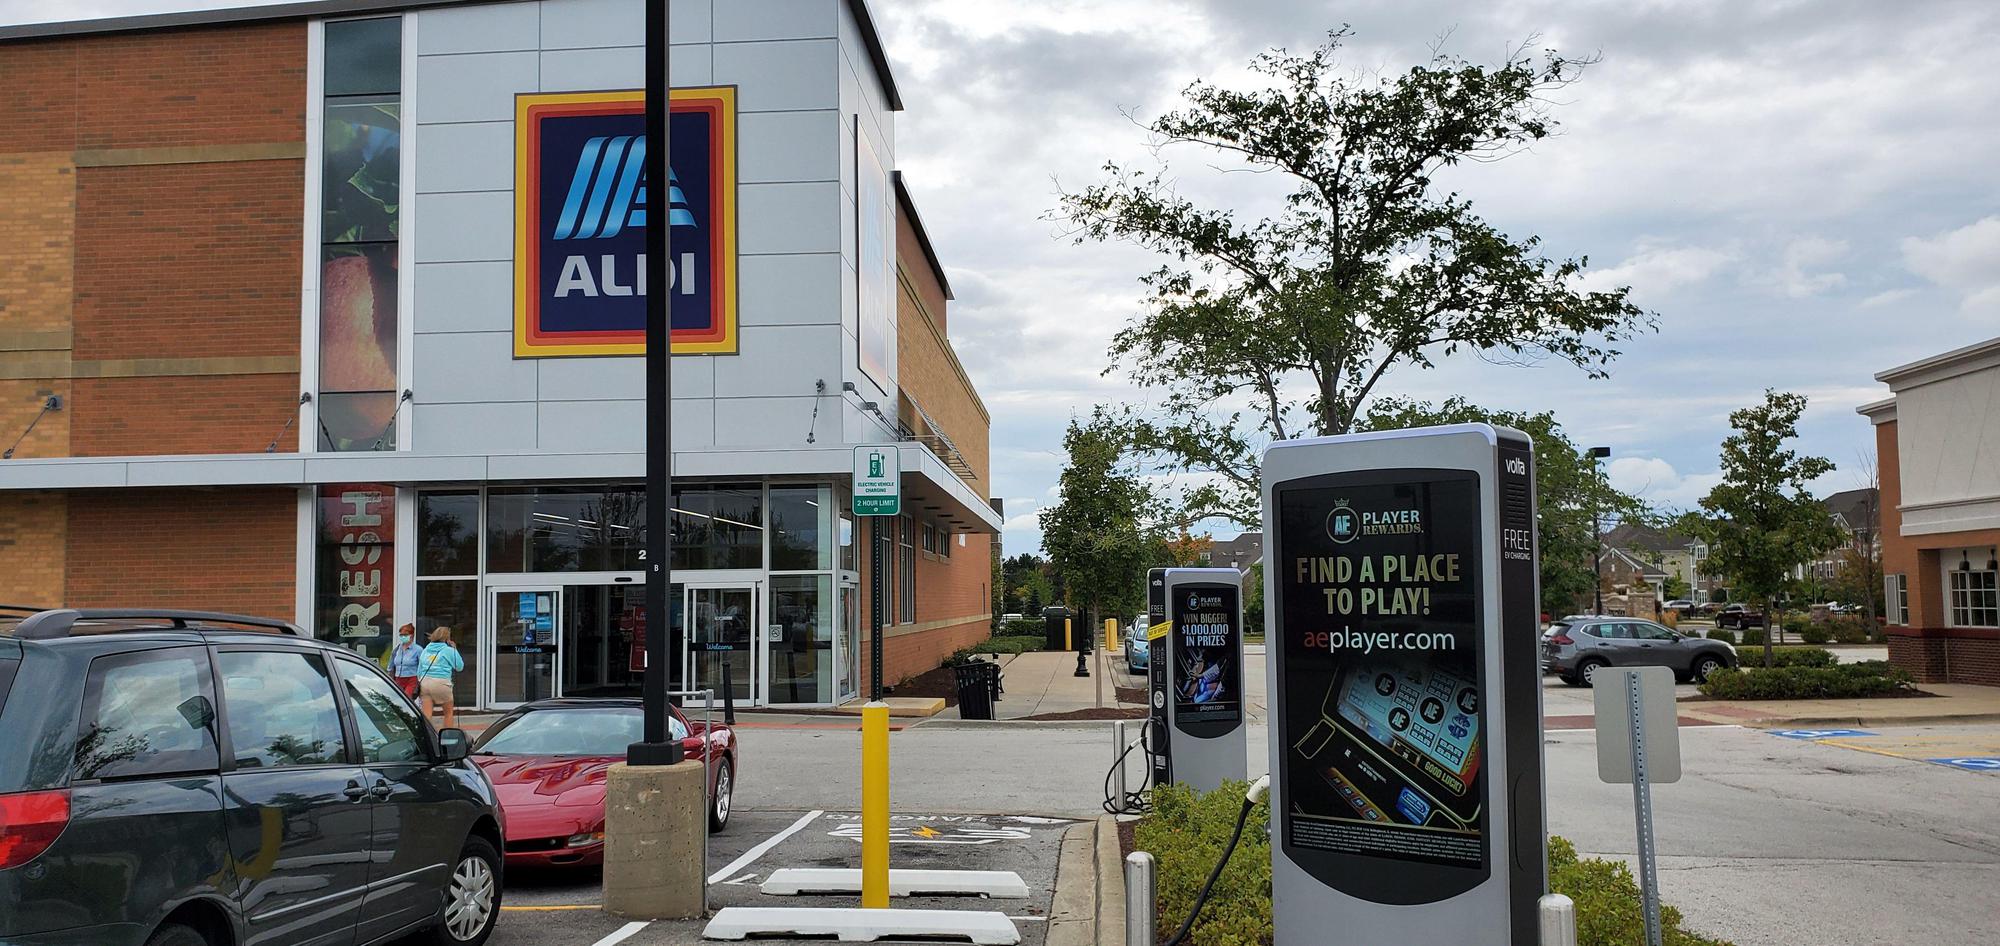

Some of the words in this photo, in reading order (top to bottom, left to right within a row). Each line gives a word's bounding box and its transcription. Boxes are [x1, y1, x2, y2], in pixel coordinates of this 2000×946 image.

[1506, 458, 1526, 475] volta
[1334, 516, 1350, 536] AE
[1362, 510, 1420, 525] PLAYER
[1504, 528, 1530, 550] FREE
[638, 550, 646, 560] 2
[1511, 552, 1530, 560] CHARGING
[1296, 556, 1352, 584] FIND
[1360, 556, 1376, 583] A
[1383, 554, 1460, 583] PLACE
[1151, 604, 1164, 613] FREE
[1323, 588, 1353, 615] TO
[1361, 588, 1430, 615] PLAY!
[1184, 613, 1198, 623] WIN
[1200, 613, 1227, 623] BIGGER!
[1182, 624, 1229, 635] $1,000,000
[1186, 636, 1194, 647] IN
[1197, 635, 1225, 647] PRIZES
[1304, 626, 1455, 654] aeplayer.com
[1424, 702, 1440, 720] AE
[1392, 712, 1406, 728] AE
[1436, 747, 1459, 764] BAR
[1440, 739, 1463, 756] BAR
[1424, 761, 1442, 777] GOOD
[1441, 772, 1463, 792] LUCK!
